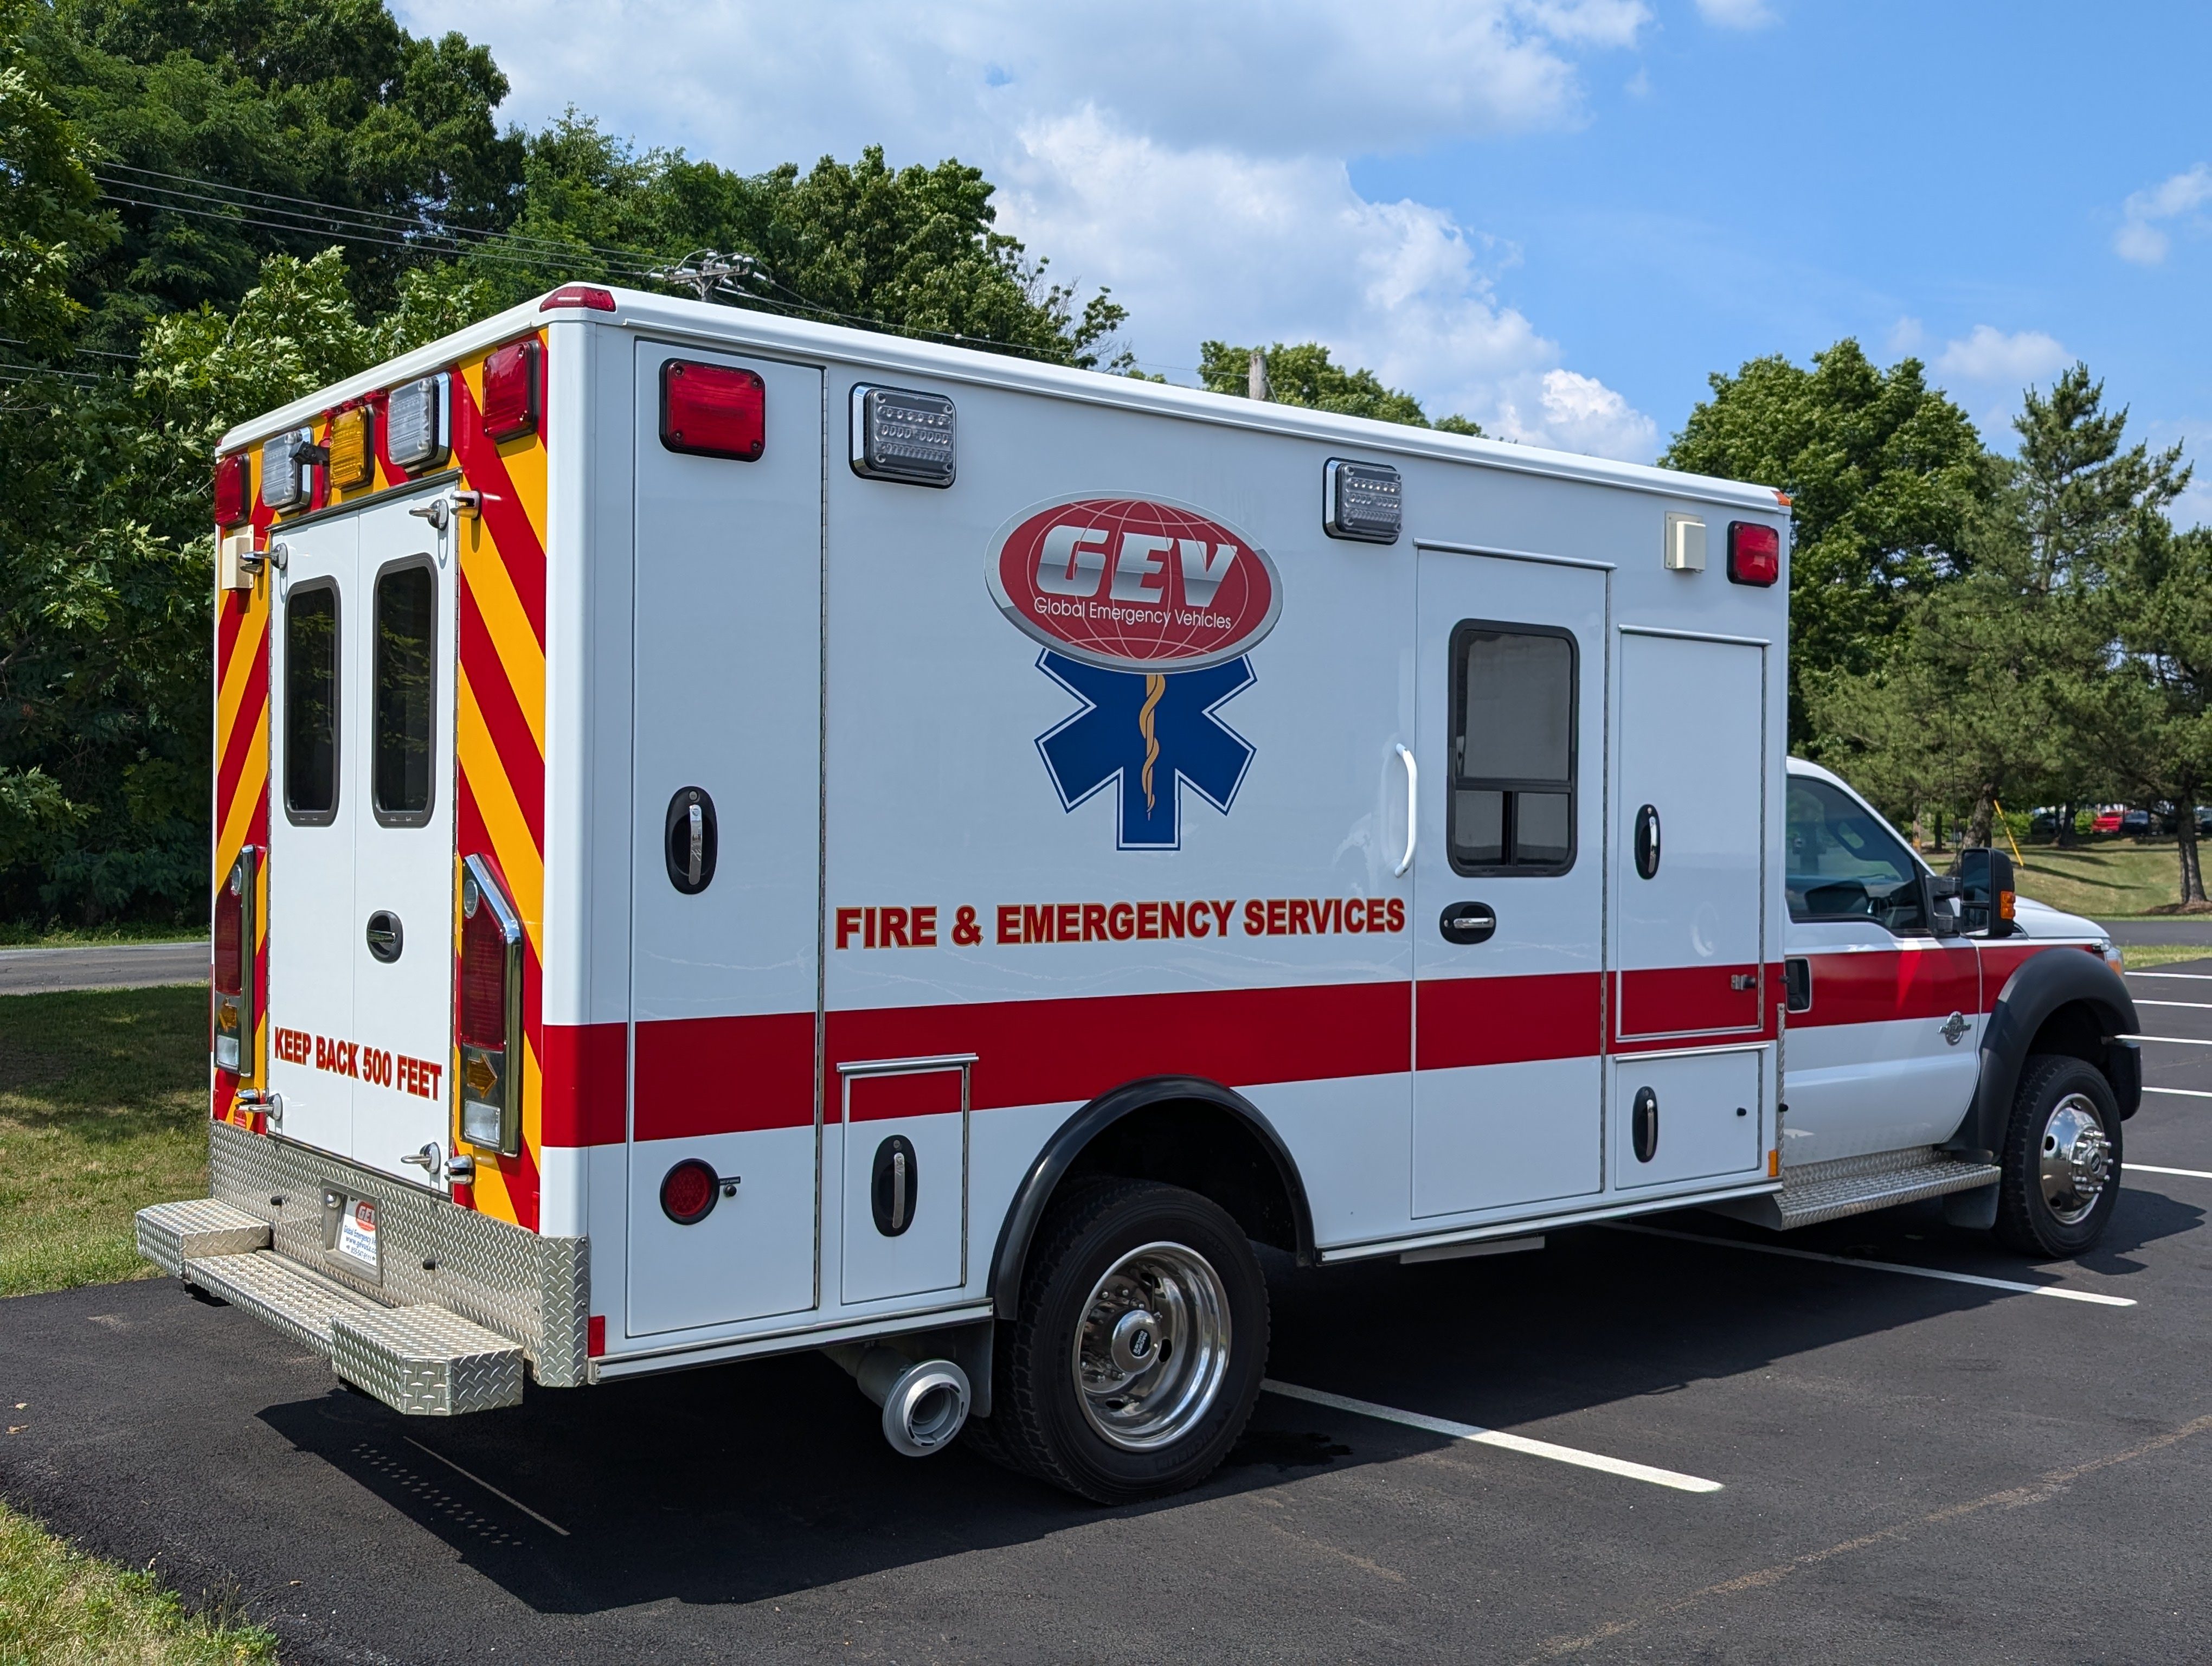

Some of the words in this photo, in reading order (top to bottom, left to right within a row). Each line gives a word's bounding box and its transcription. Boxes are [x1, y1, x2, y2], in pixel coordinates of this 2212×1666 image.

[1036, 524, 1238, 607] GEV
[1034, 597, 1085, 617] Global
[1089, 601, 1171, 625] Emergency
[1175, 608, 1231, 629] Vehicles
[835, 906, 937, 950] FIRE
[951, 905, 984, 946] &
[996, 899, 1237, 945] EMERGENCY
[1243, 898, 1405, 936] SERVICES
[274, 1026, 312, 1066] KEEP
[316, 1035, 360, 1080] BACK
[362, 1046, 393, 1088] 500
[397, 1054, 442, 1101] FEET
